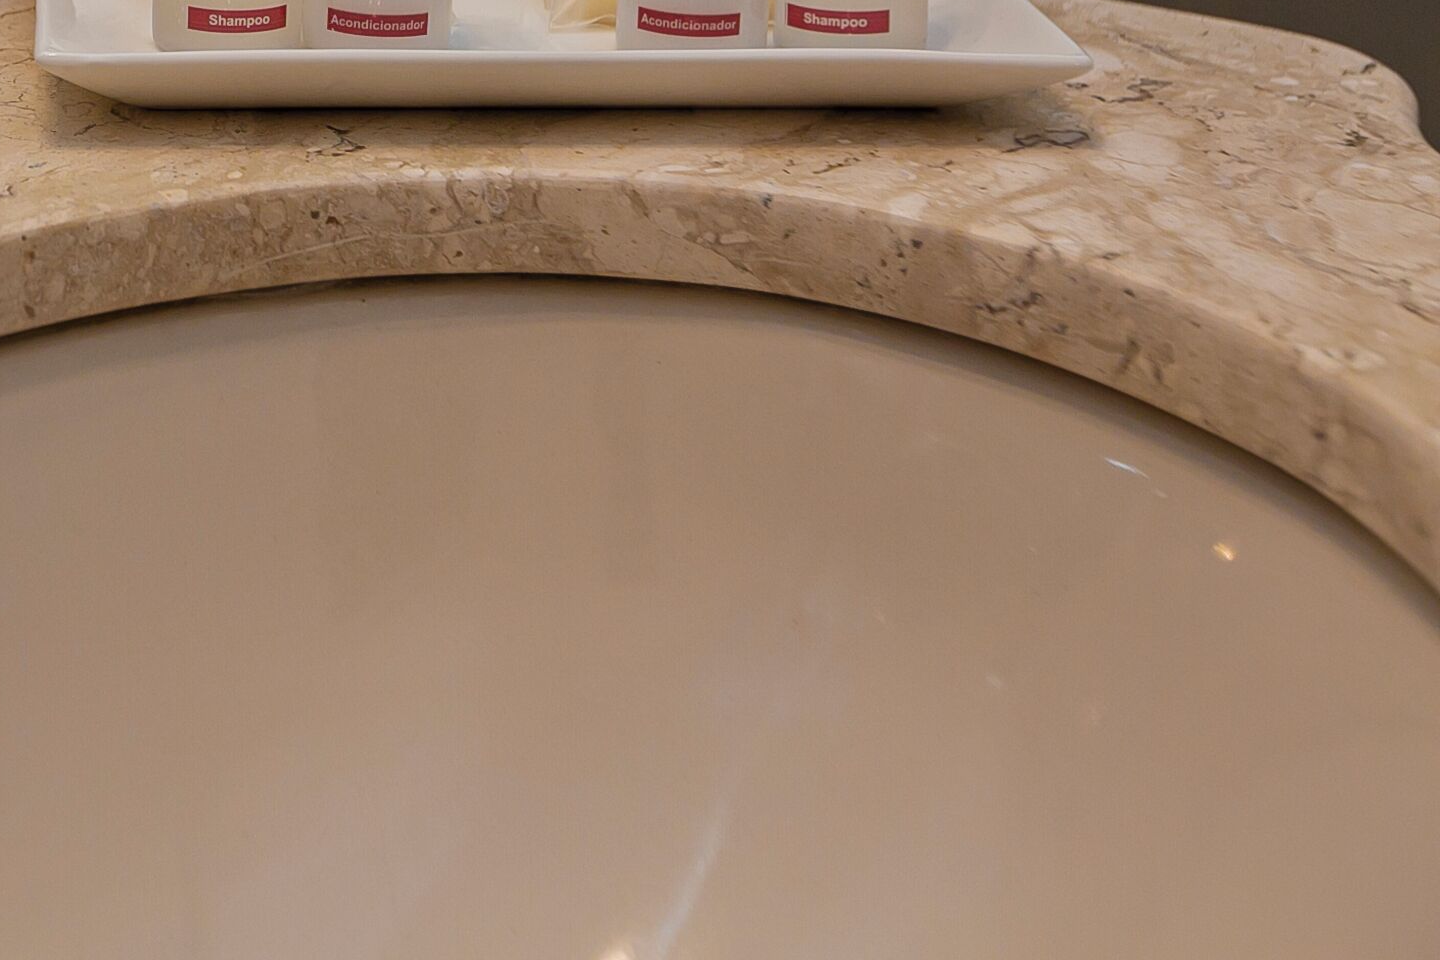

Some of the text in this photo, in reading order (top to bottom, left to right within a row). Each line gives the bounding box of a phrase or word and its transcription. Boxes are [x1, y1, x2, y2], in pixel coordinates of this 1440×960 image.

[208, 14, 270, 28] Shampoo
[330, 14, 425, 31] Acondicionador
[641, 13, 736, 31] Acondicionador
[803, 12, 868, 29] Shampoo
